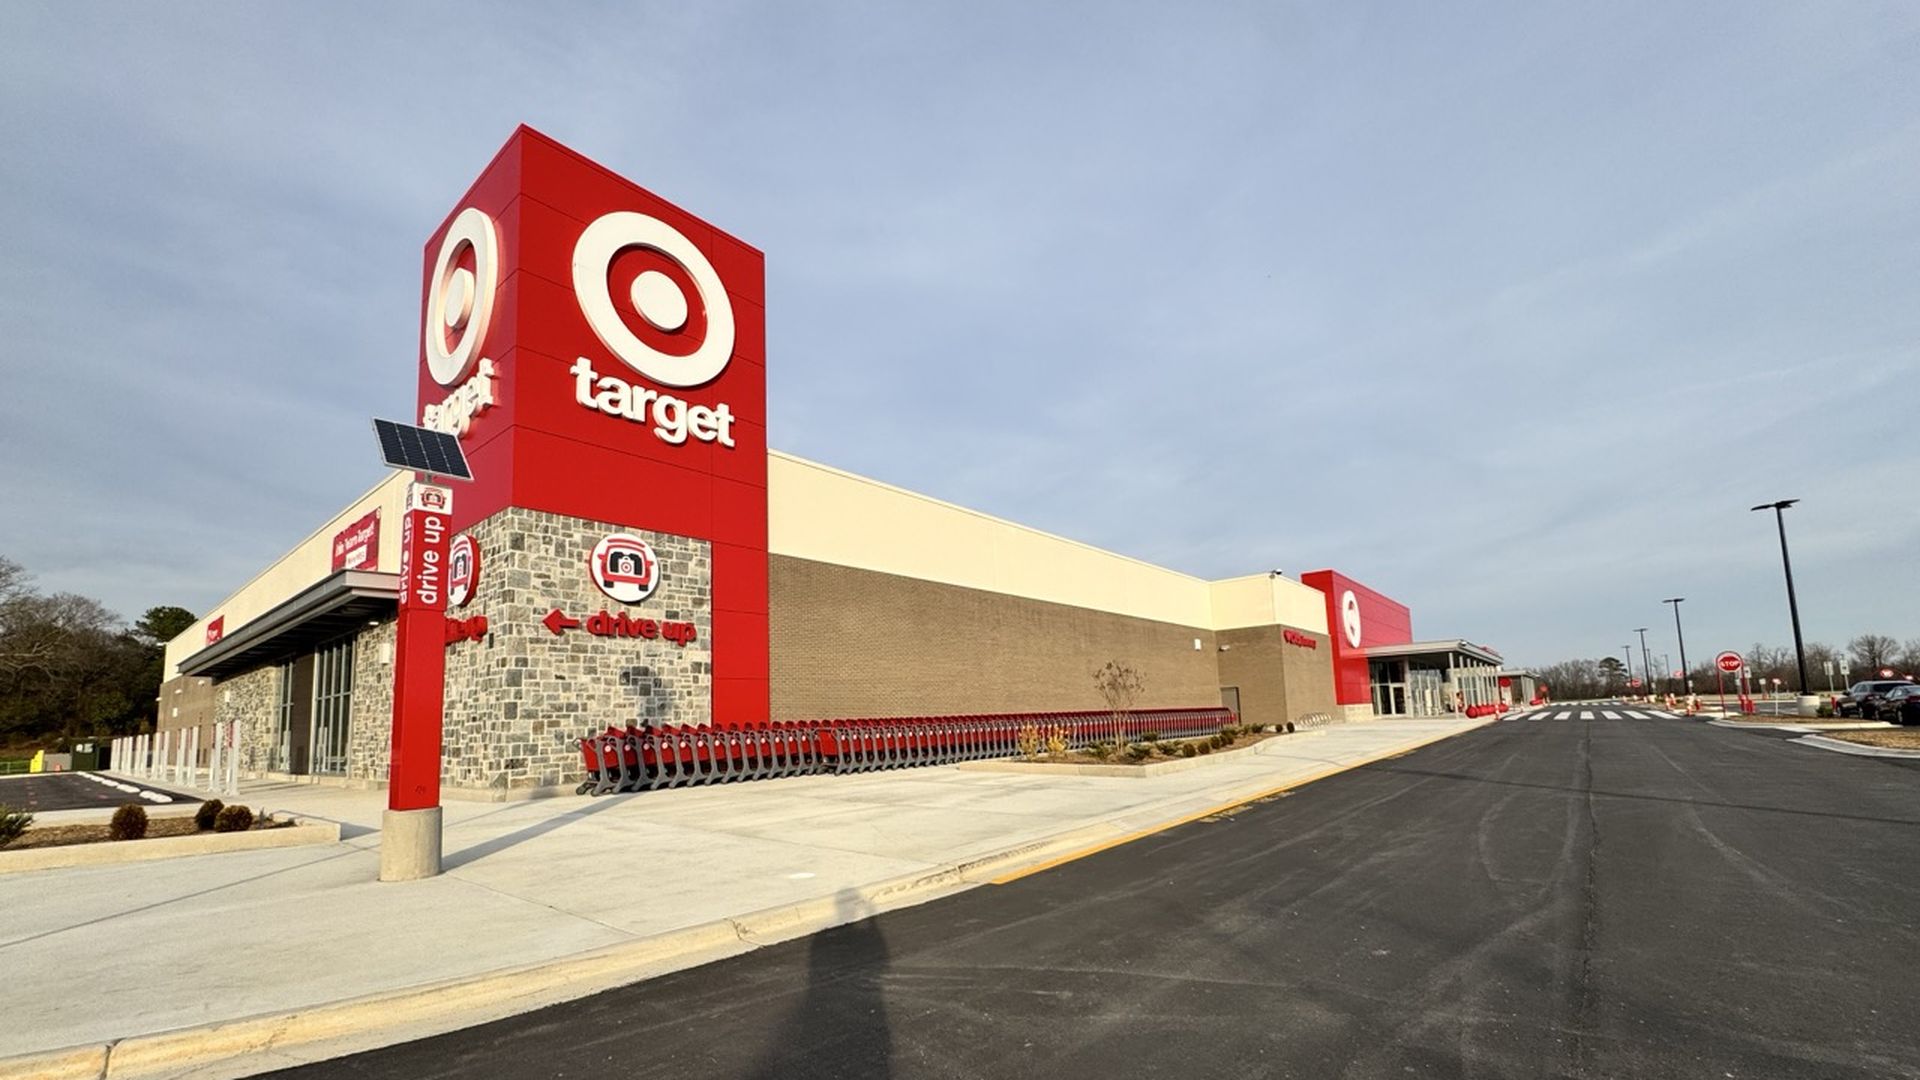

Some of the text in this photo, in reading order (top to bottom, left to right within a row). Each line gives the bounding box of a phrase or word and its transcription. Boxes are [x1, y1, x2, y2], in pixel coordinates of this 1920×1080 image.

[423, 357, 495, 438] target
[570, 356, 736, 447] target
[417, 516, 445, 604] drive up
[586, 610, 698, 647] drive up
